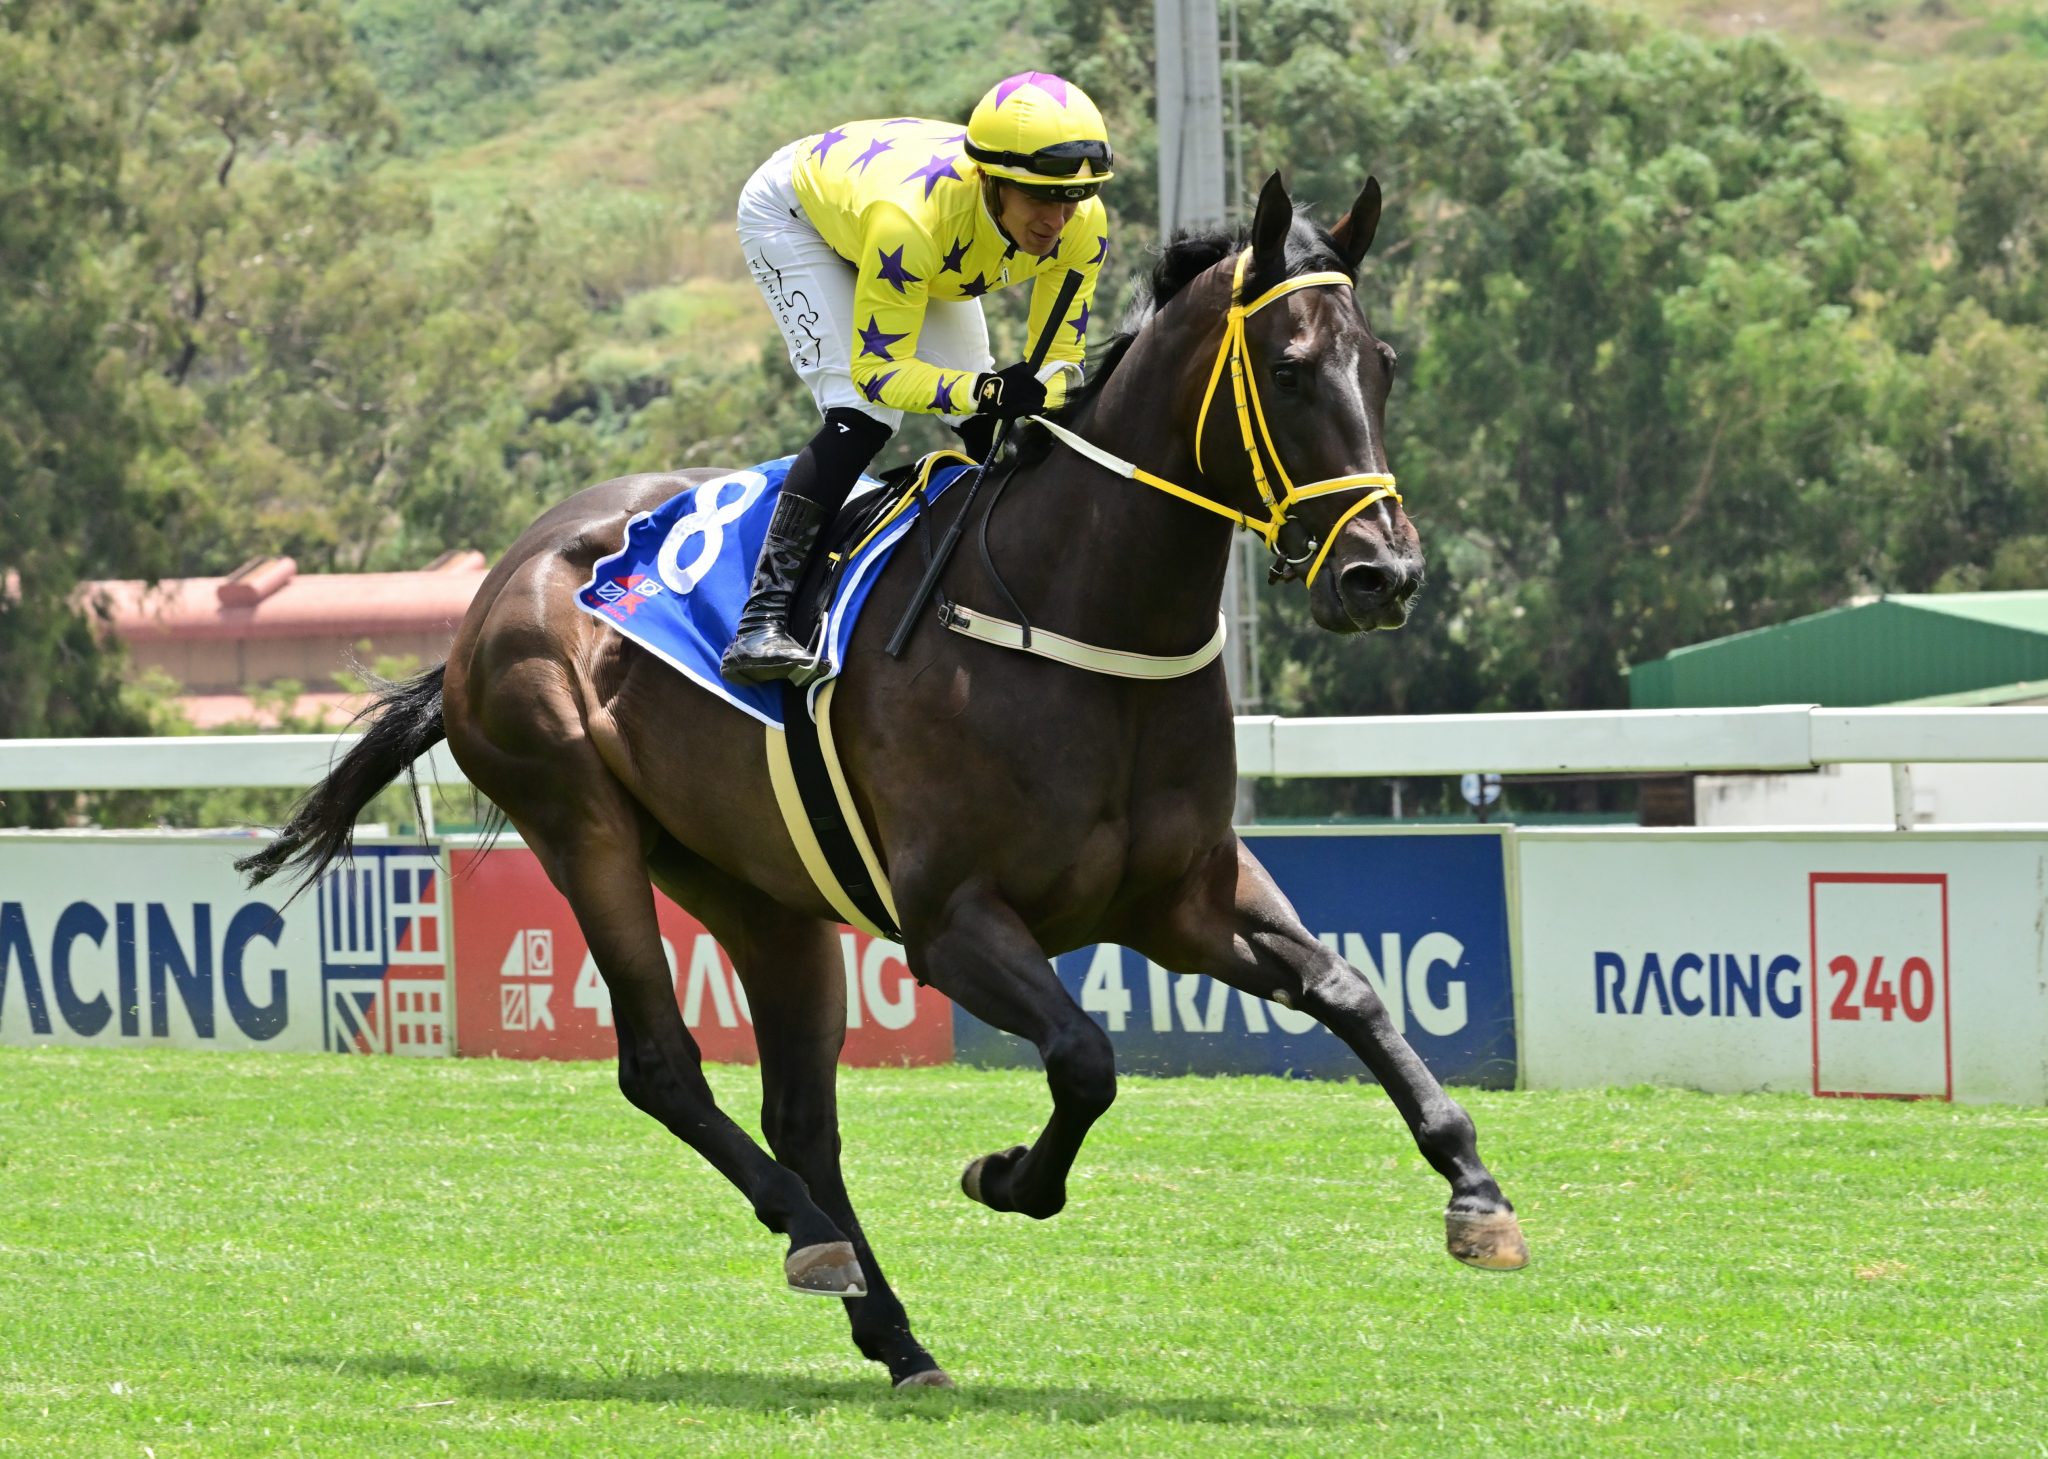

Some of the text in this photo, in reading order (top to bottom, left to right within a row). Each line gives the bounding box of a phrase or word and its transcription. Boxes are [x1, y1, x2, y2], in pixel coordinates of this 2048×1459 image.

[657, 470, 768, 595] 8
[1081, 943, 1132, 1032] 4
[1594, 951, 1935, 1023] RACING 240
